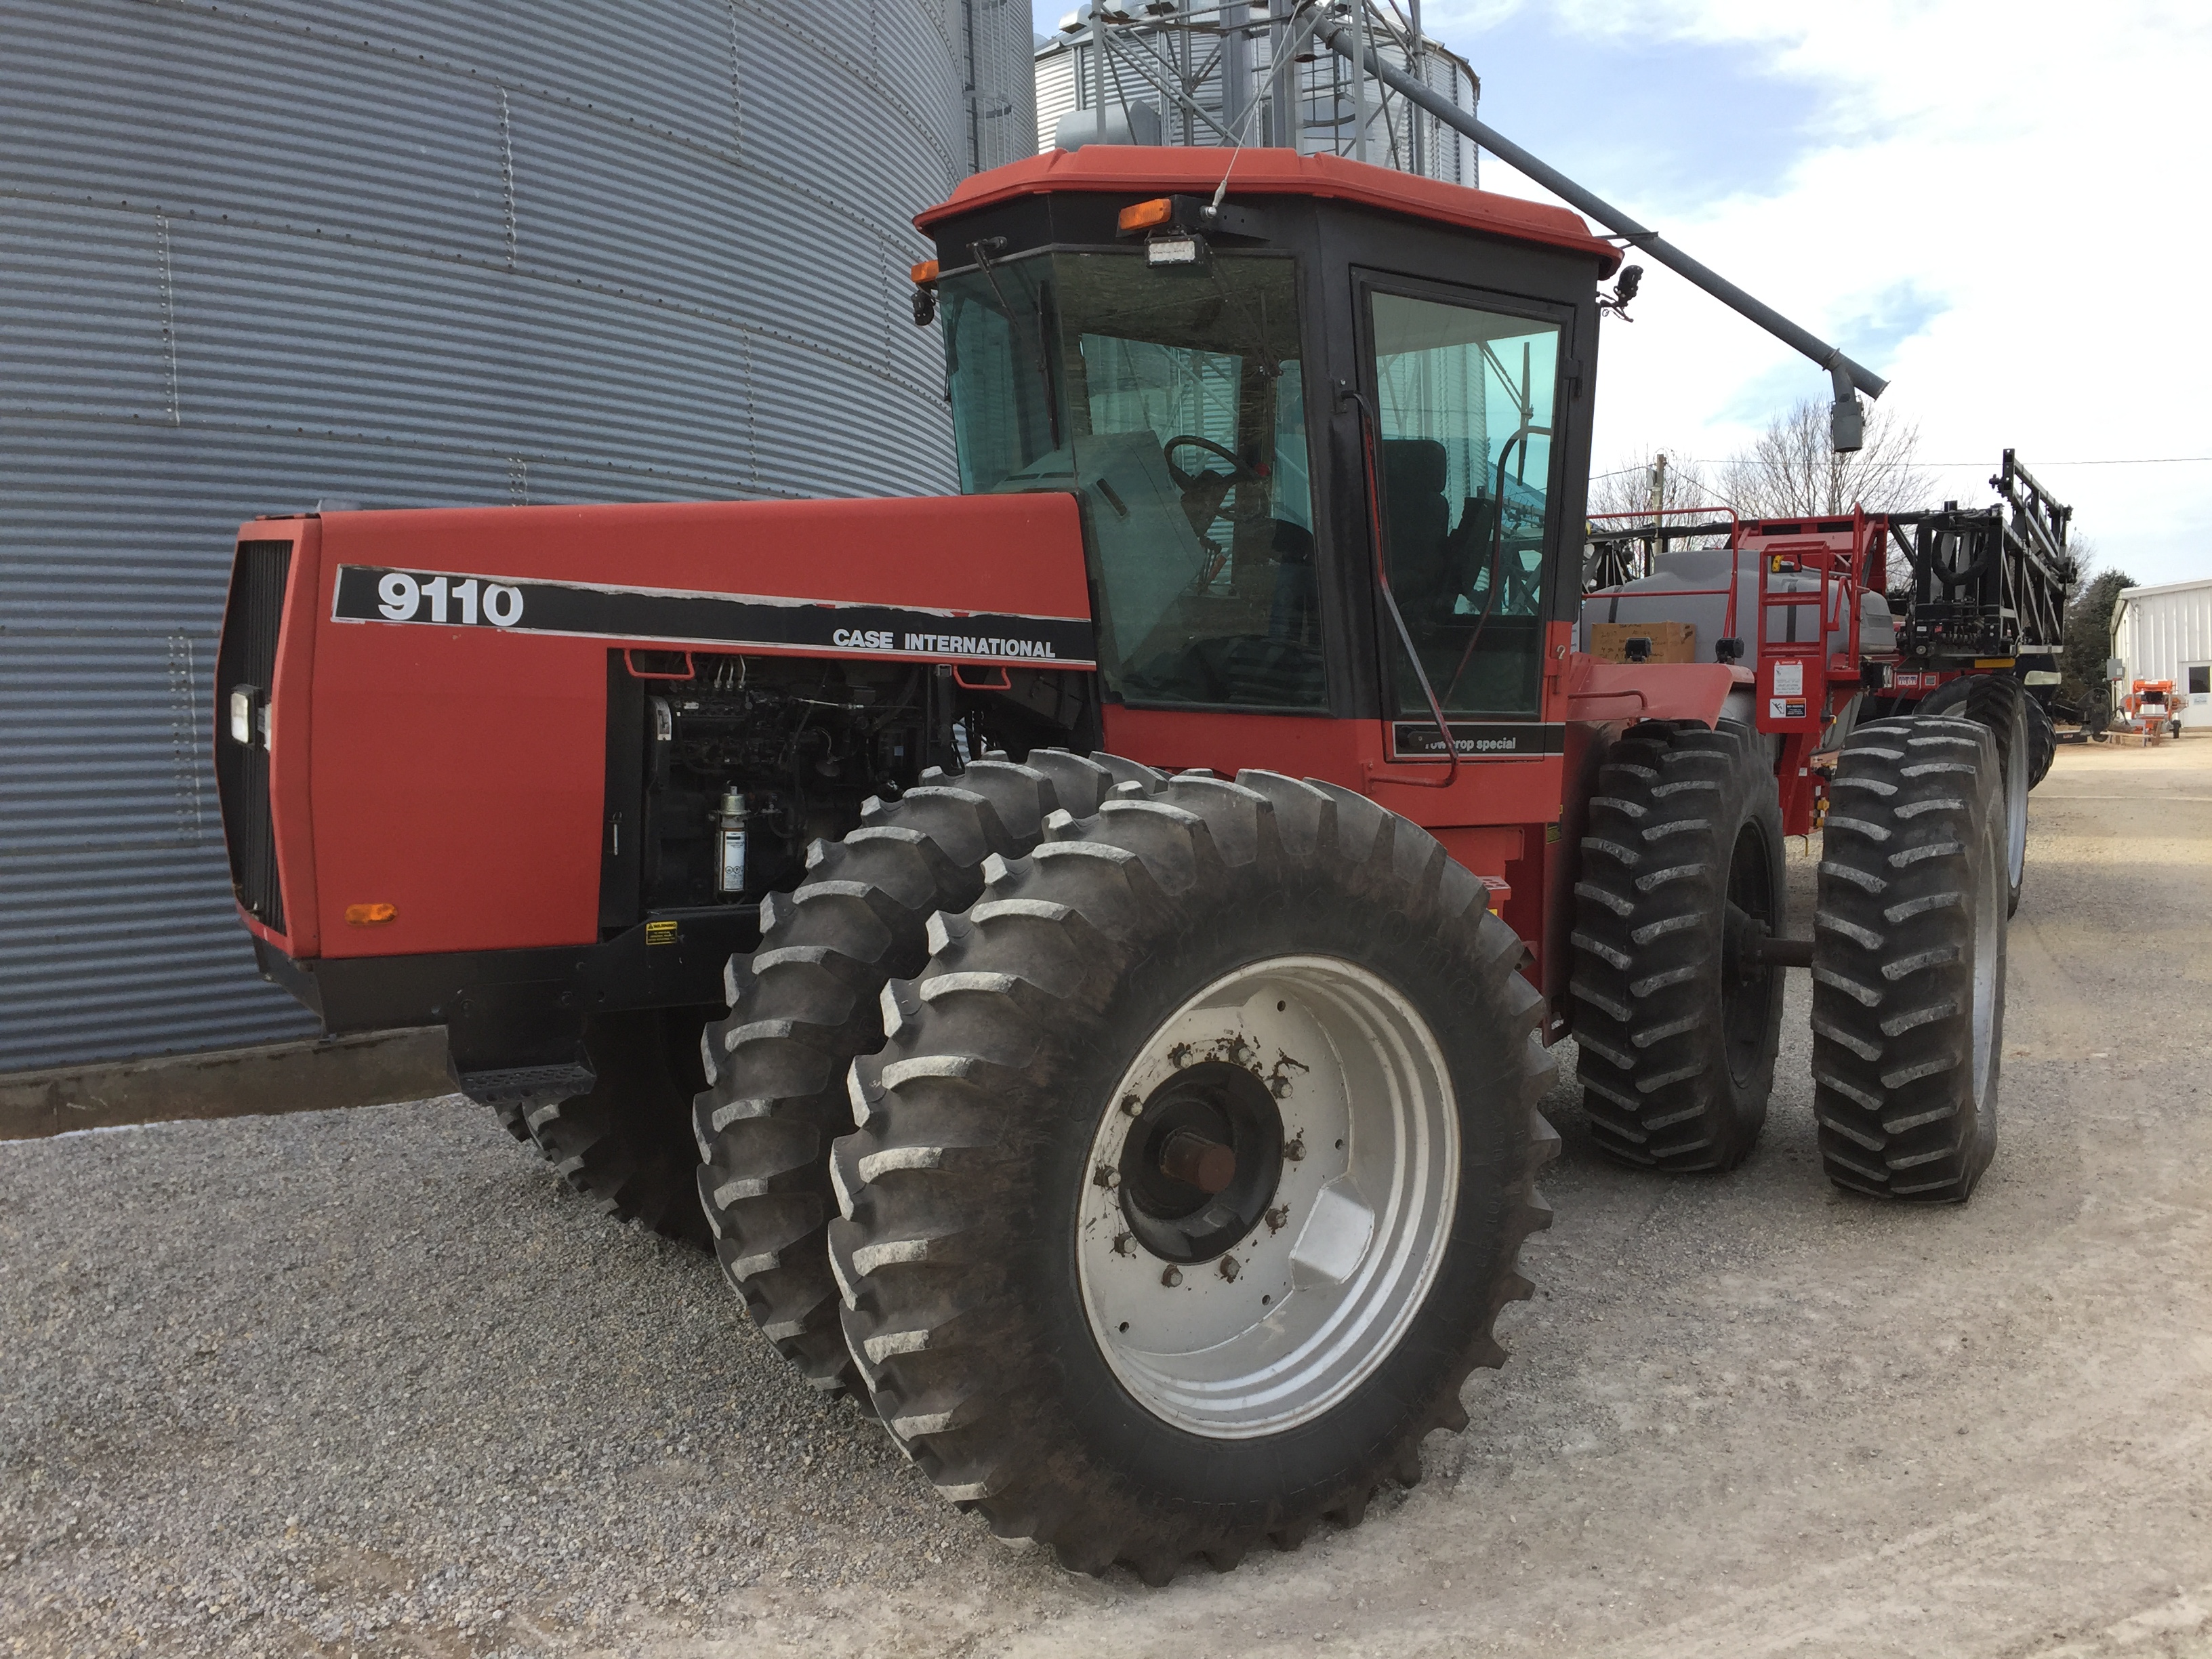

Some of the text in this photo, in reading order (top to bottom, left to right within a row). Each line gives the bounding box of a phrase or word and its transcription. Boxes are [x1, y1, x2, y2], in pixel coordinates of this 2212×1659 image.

[377, 573, 525, 627] 9110
[833, 628, 1056, 657] CASE INTERNATIONAL
[1453, 739, 1475, 752] rop
[1476, 737, 1516, 752] special
